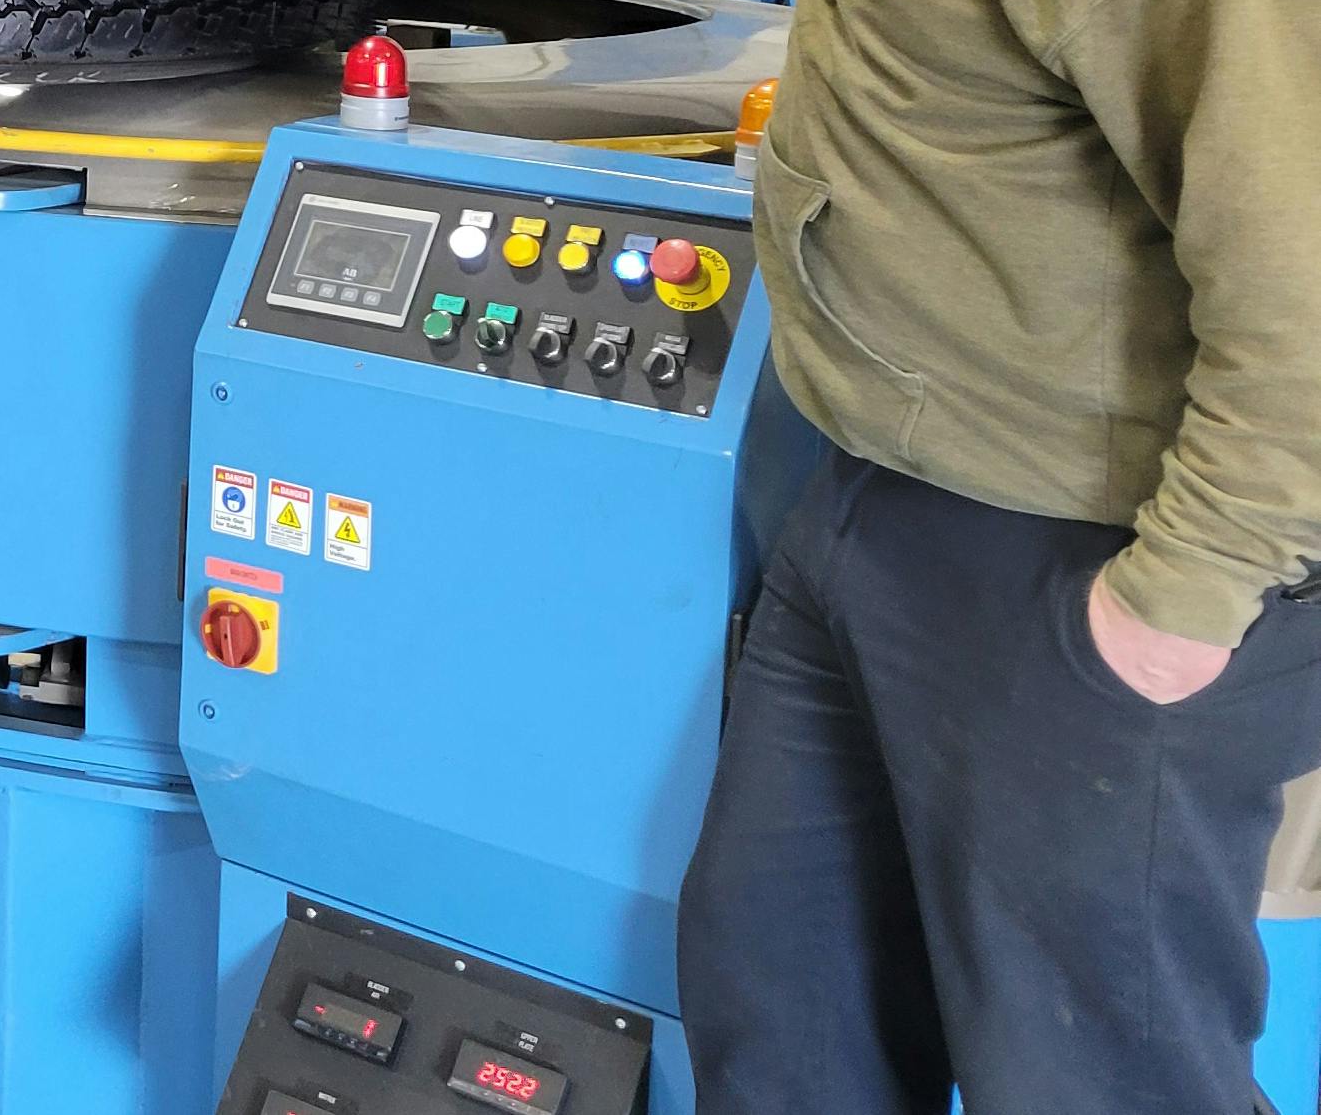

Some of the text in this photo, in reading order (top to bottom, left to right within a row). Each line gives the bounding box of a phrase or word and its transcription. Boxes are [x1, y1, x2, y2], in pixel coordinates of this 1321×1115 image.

[699, 248, 726, 272] GENCY
[669, 297, 698, 309] STOP
[224, 472, 253, 487] DANGER
[478, 1061, 538, 1099] 2522
